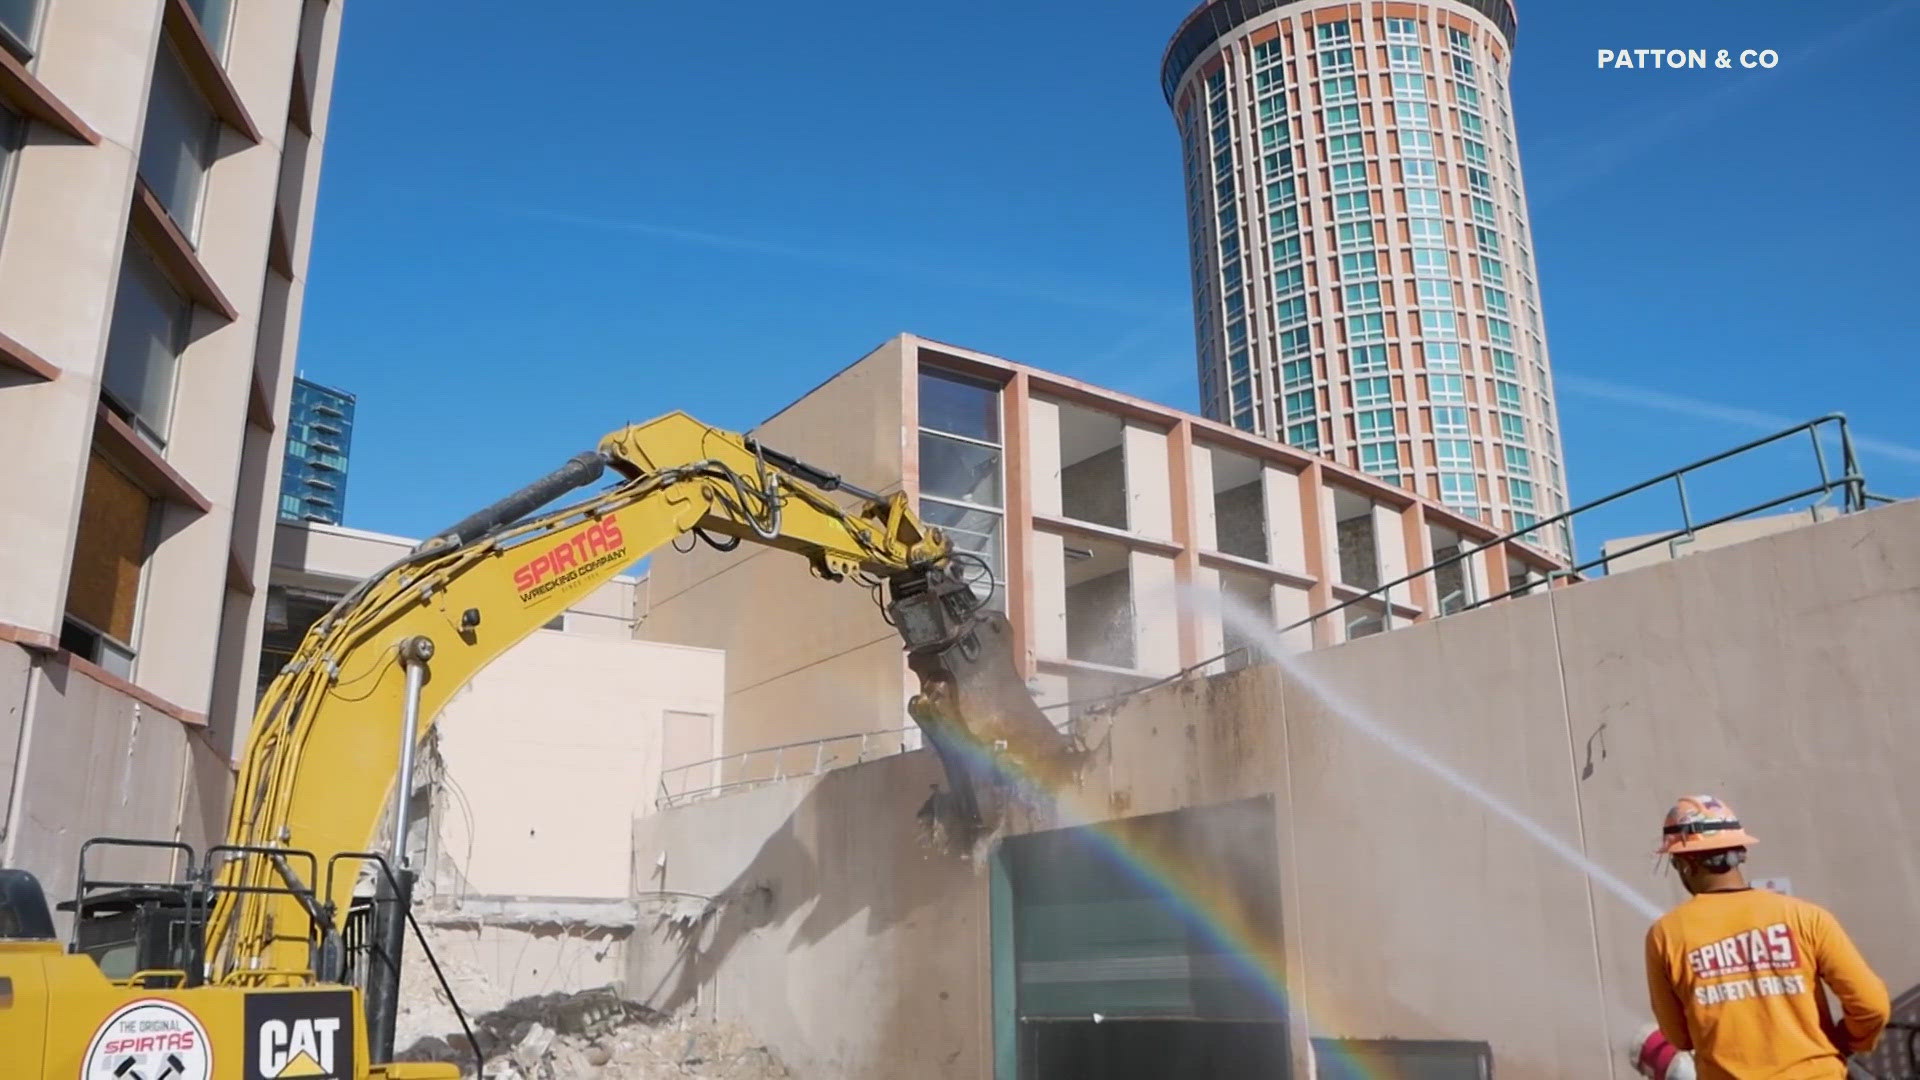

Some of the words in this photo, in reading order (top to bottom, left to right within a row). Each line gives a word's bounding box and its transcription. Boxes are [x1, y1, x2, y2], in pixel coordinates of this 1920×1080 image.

[513, 514, 623, 592] SPIRTAS
[520, 568, 578, 602] WRECKING
[578, 547, 627, 576] COMPANY
[1688, 923, 1792, 971] SPIRTAS
[1695, 979, 1756, 1005] SAFETY
[1757, 974, 1806, 996] FIRST
[104, 1031, 194, 1054] SPIRTAS
[119, 1020, 136, 1033] THE
[139, 1020, 181, 1032] ORIGINAL
[259, 1017, 340, 1079] CAT
